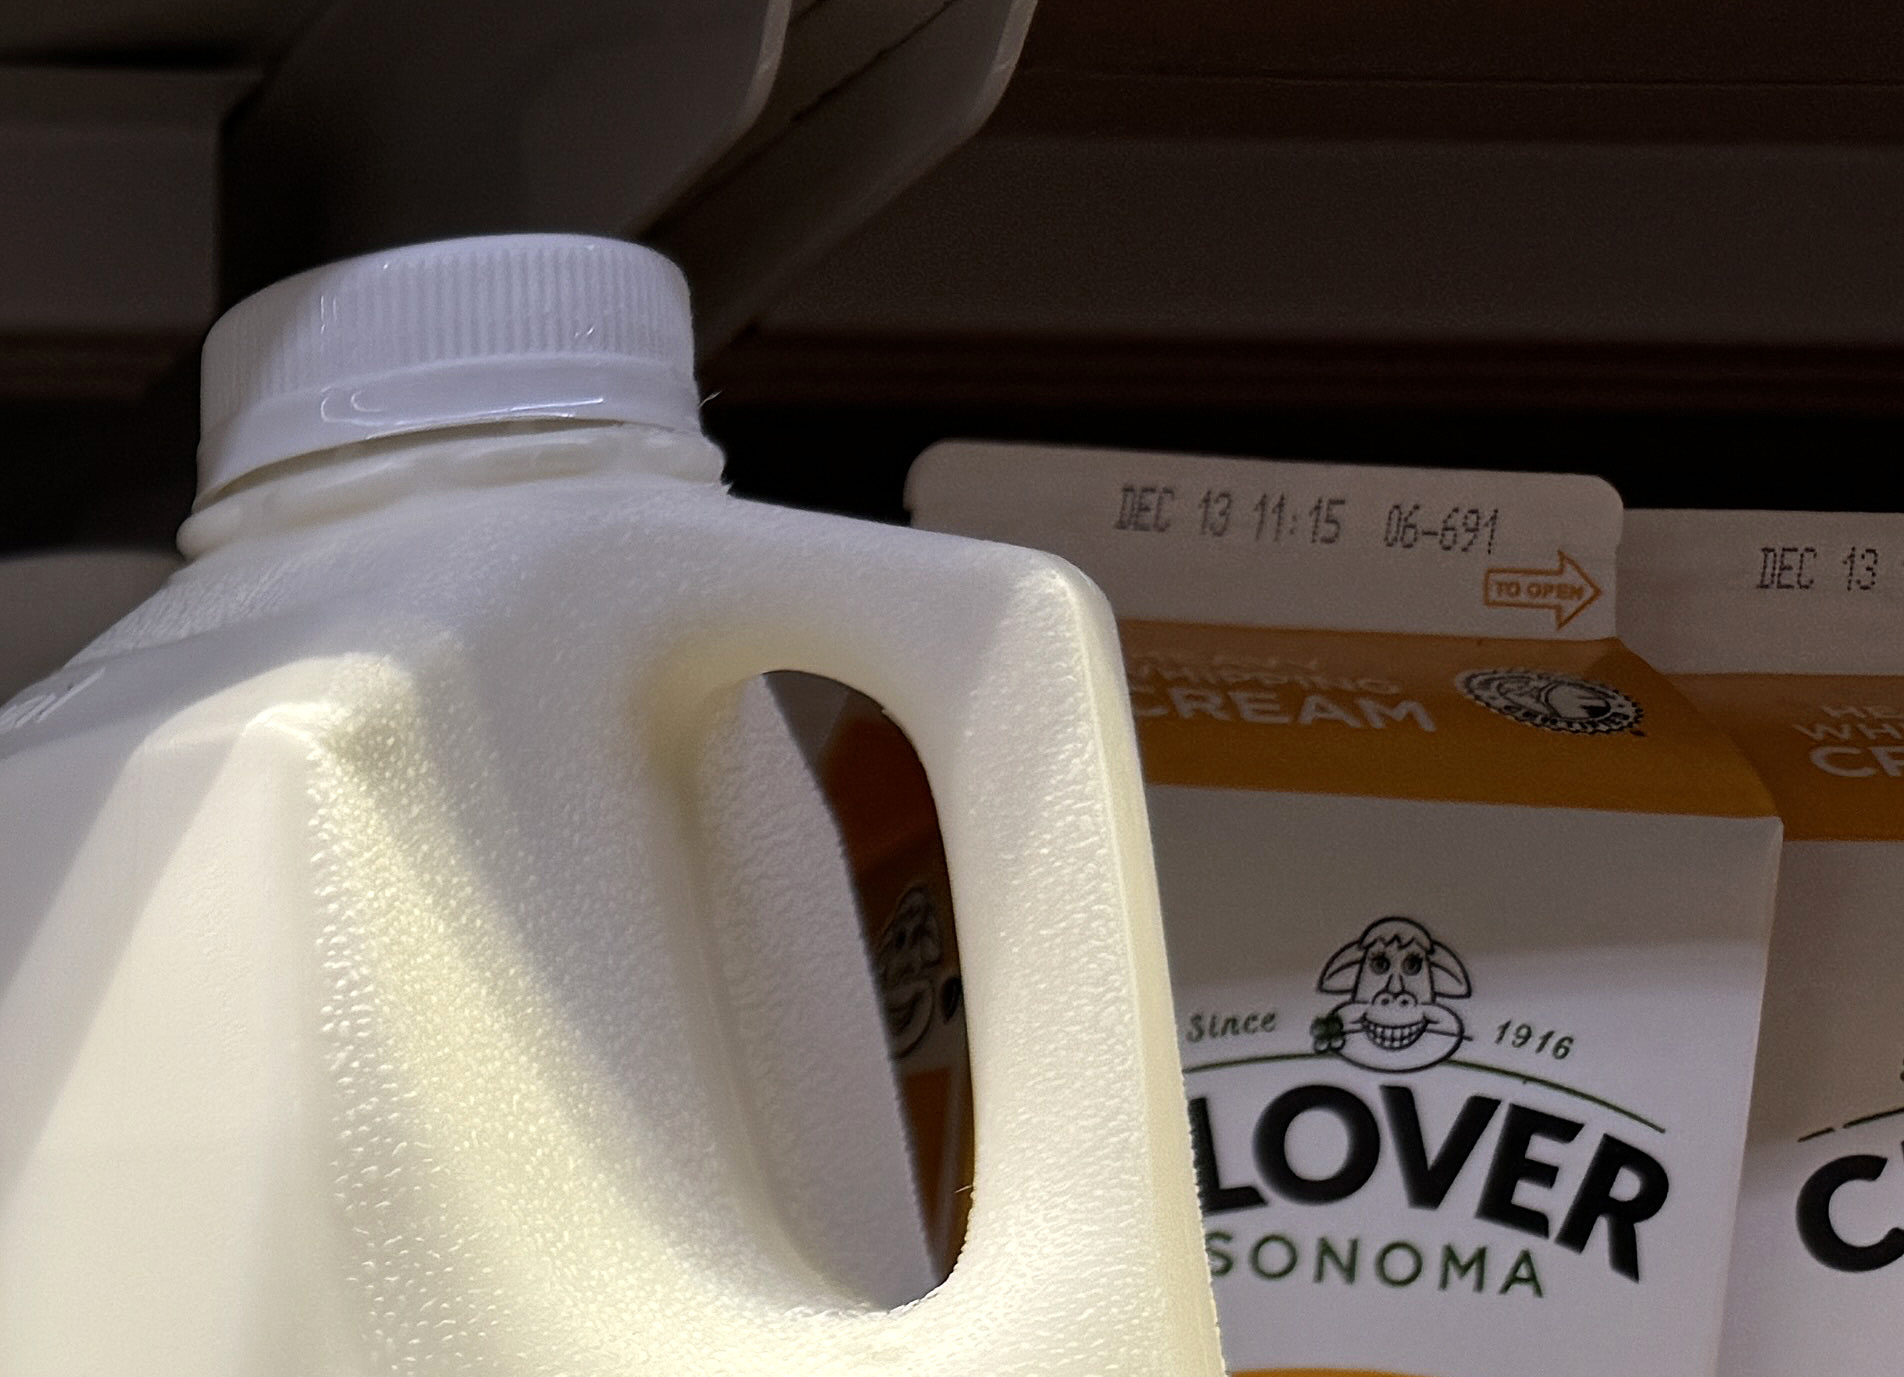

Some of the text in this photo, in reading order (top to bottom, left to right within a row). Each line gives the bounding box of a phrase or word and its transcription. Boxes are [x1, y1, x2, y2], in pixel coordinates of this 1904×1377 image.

[1115, 485, 1175, 532] DEC
[1199, 490, 1231, 536] 13
[1254, 493, 1345, 544] 11:15
[1496, 582, 1584, 599] TO OPEN
[1186, 1010, 1575, 1060] Since 1916
[1188, 1084, 1669, 1283] LOVER
[1206, 1230, 1543, 1298] SONOMA
